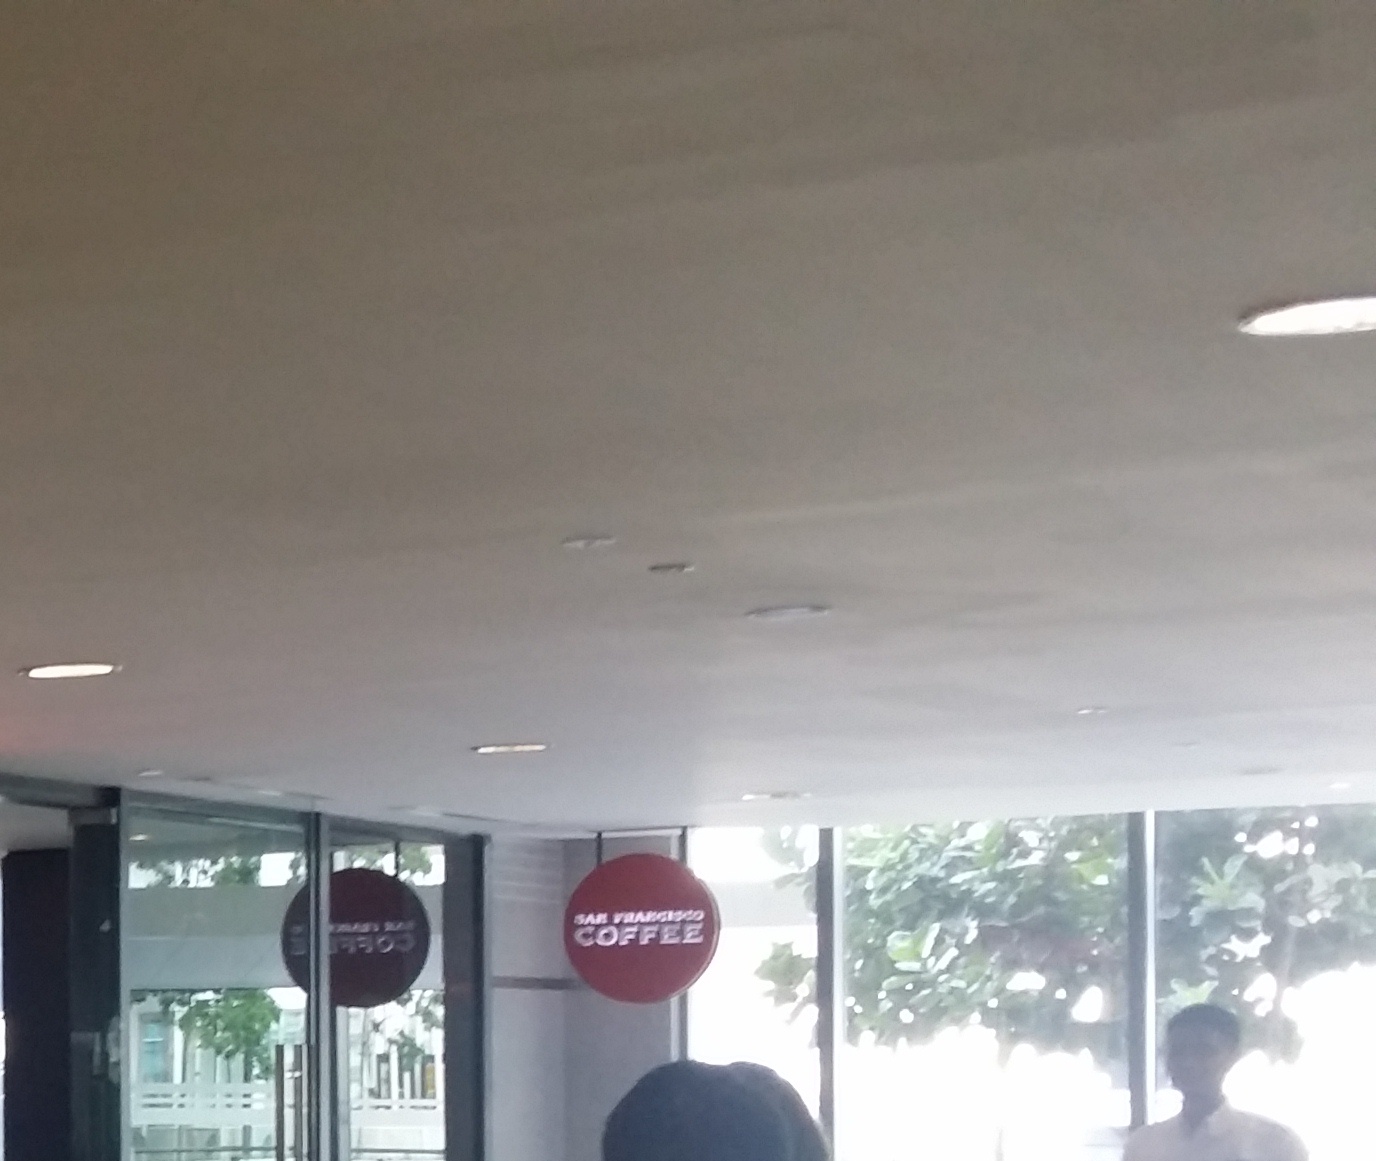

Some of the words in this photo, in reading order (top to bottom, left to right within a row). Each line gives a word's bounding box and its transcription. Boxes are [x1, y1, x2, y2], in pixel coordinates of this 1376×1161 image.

[573, 912, 608, 925] SAN
[612, 909, 705, 924] FRANCISCO
[573, 922, 705, 947] COFFEE
